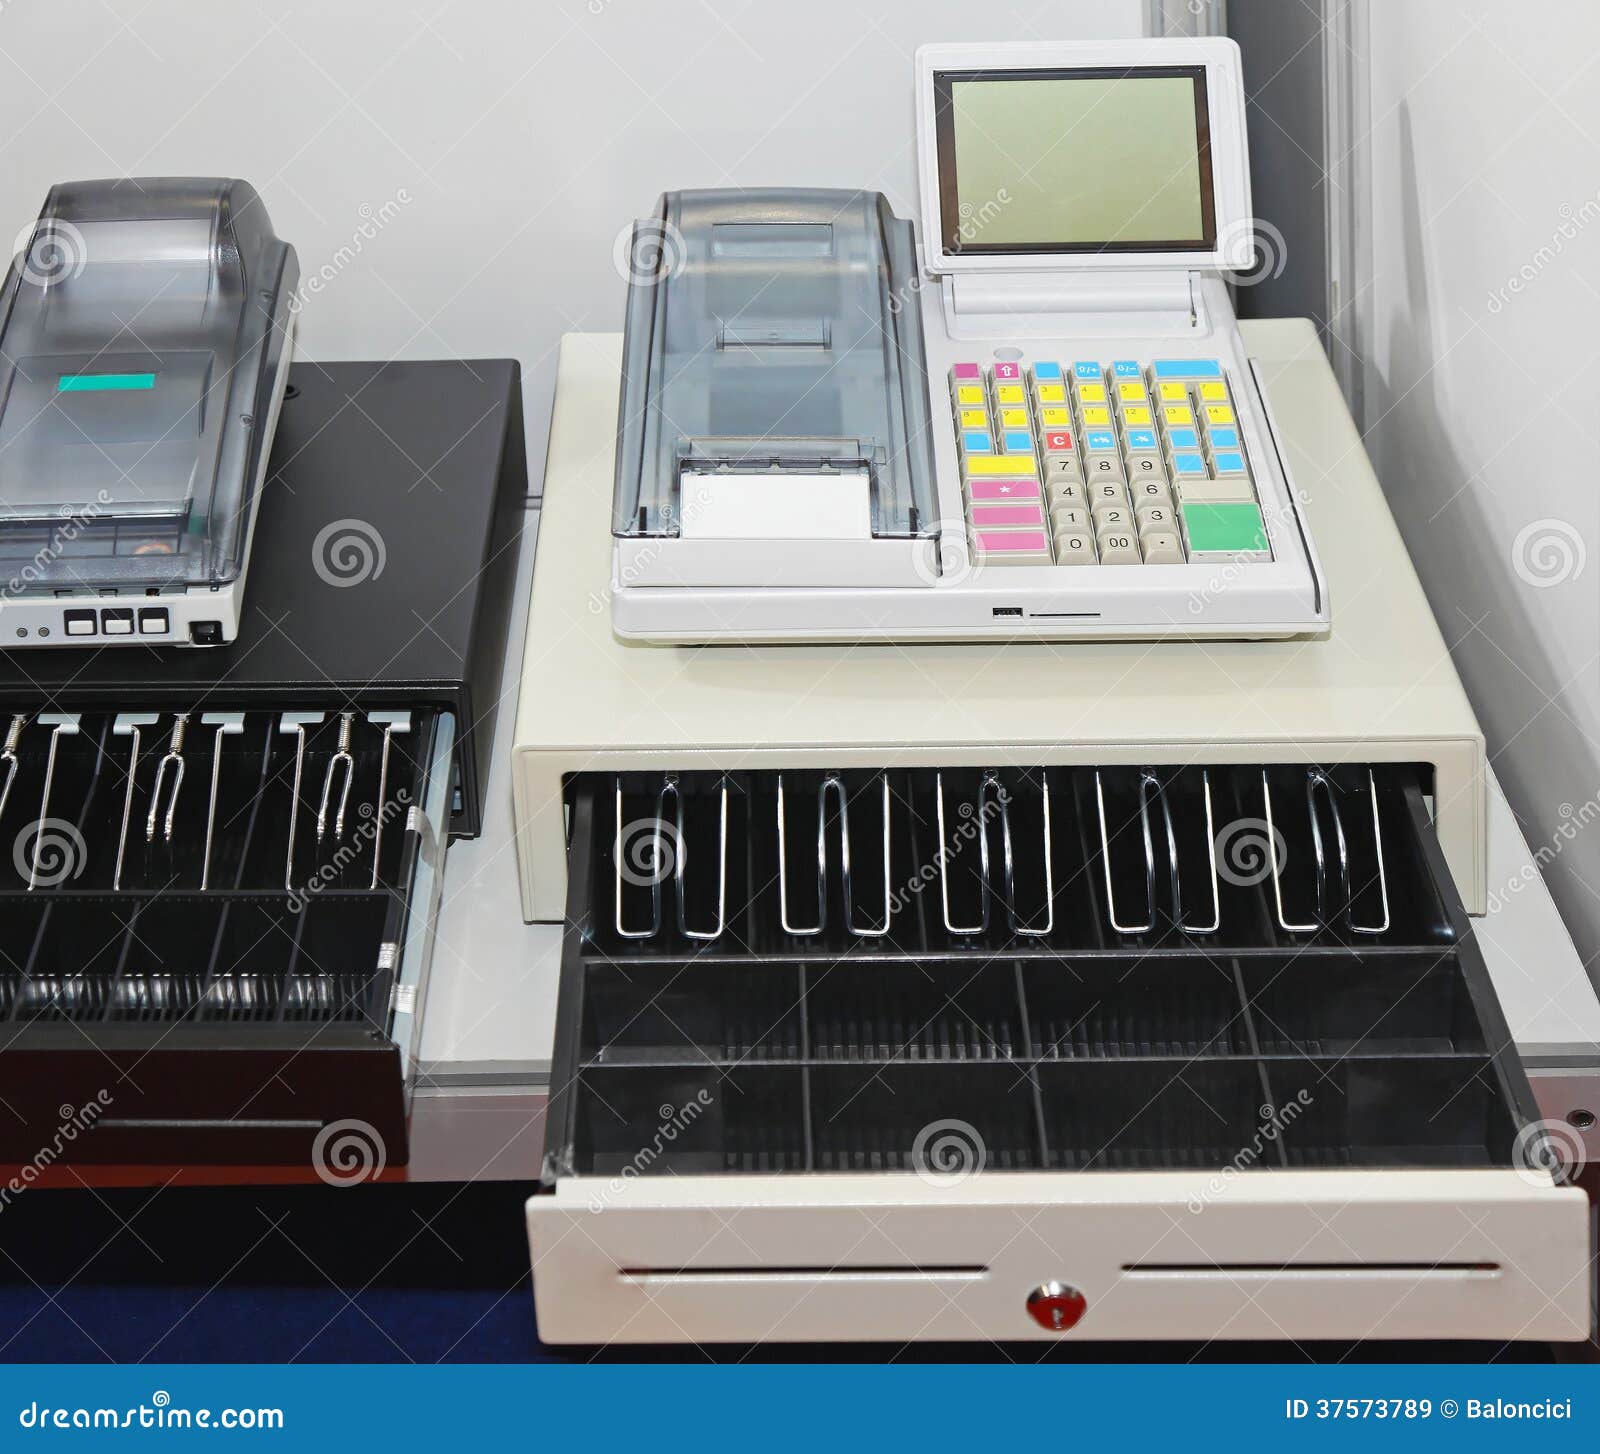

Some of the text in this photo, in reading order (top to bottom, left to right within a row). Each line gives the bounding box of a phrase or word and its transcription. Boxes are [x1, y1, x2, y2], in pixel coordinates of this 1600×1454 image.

[1053, 436, 1065, 446] C
[1059, 461, 1069, 471] 7
[1099, 461, 1112, 471] 8
[1141, 460, 1153, 471] 9
[1062, 486, 1074, 497] 4
[1103, 486, 1115, 497] 5
[1146, 484, 1158, 495] 6
[1067, 512, 1075, 523] 1
[1108, 511, 1121, 522] 2
[1151, 510, 1163, 521] 3
[1109, 537, 1129, 548] 00
